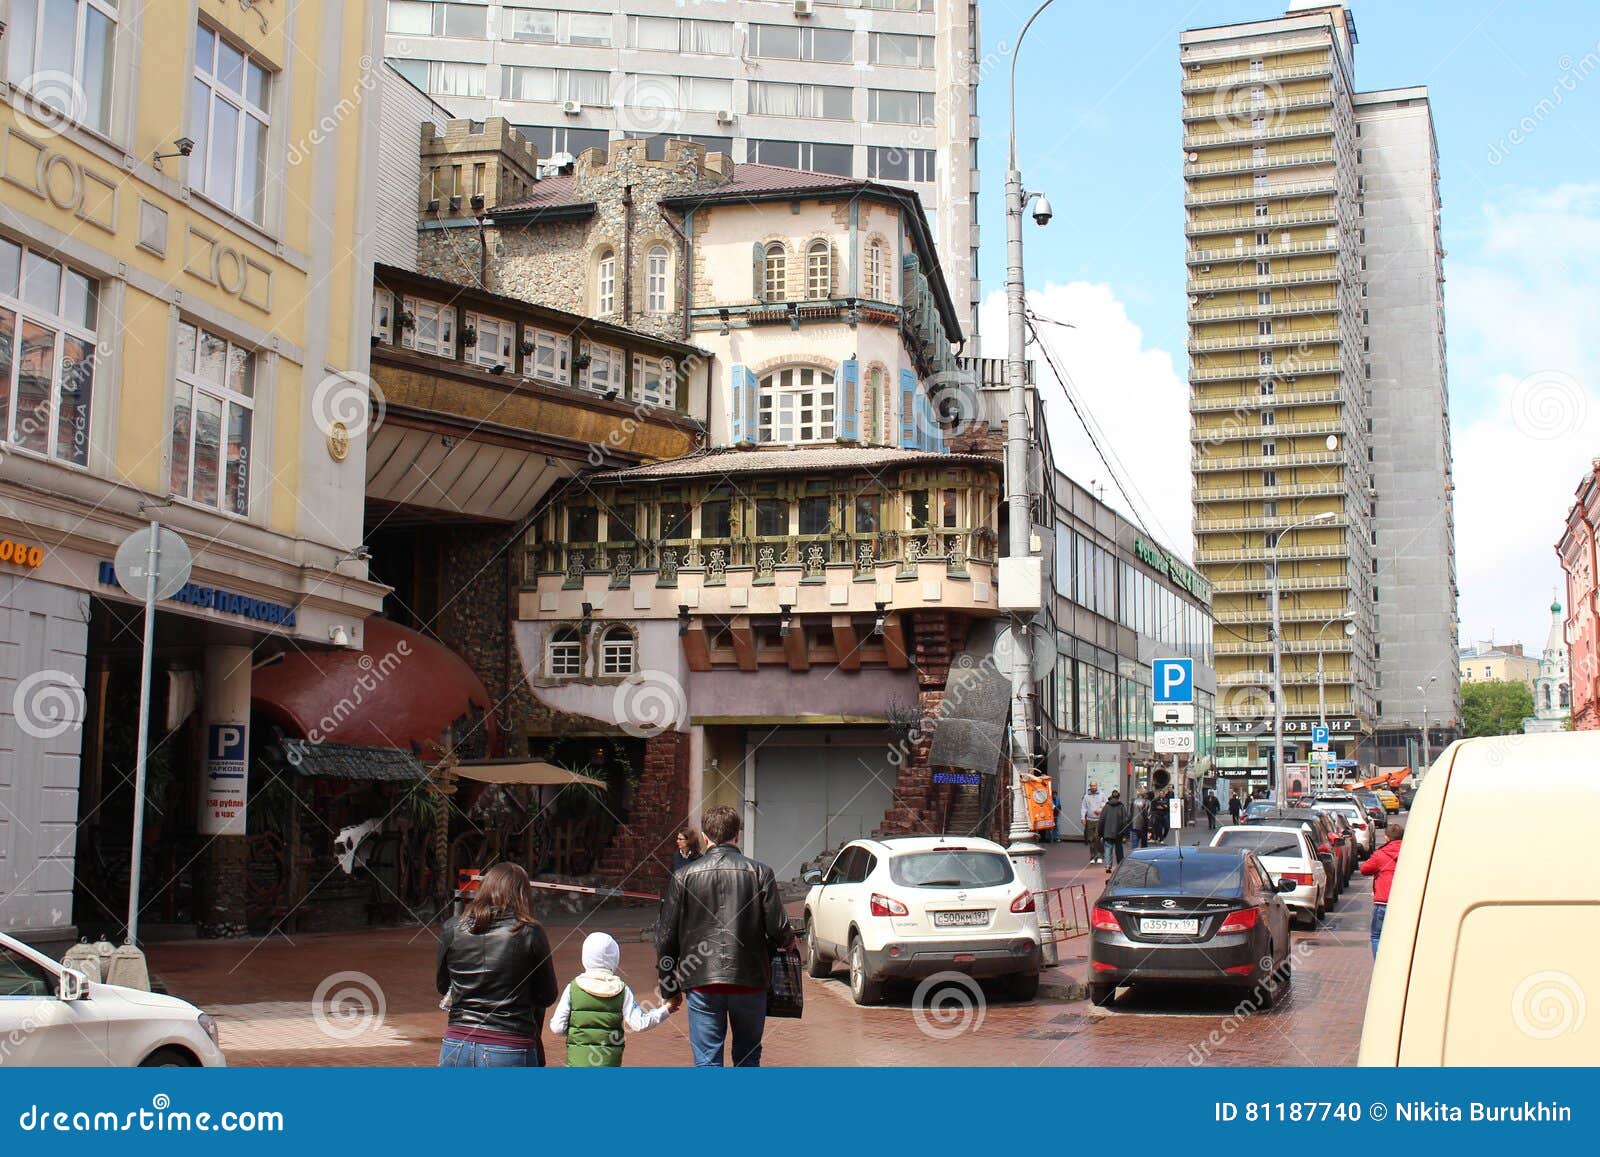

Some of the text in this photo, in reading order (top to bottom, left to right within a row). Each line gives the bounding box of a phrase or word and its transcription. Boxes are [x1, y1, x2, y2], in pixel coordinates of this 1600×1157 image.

[74, 404, 87, 457] YOGA
[237, 446, 248, 516] STUDIO
[1163, 663, 1186, 698] P
[1167, 737, 1175, 746] 15
[1178, 736, 1190, 747] 20
[1284, 721, 1352, 731] ЮВЕИР
[218, 728, 240, 757] P
